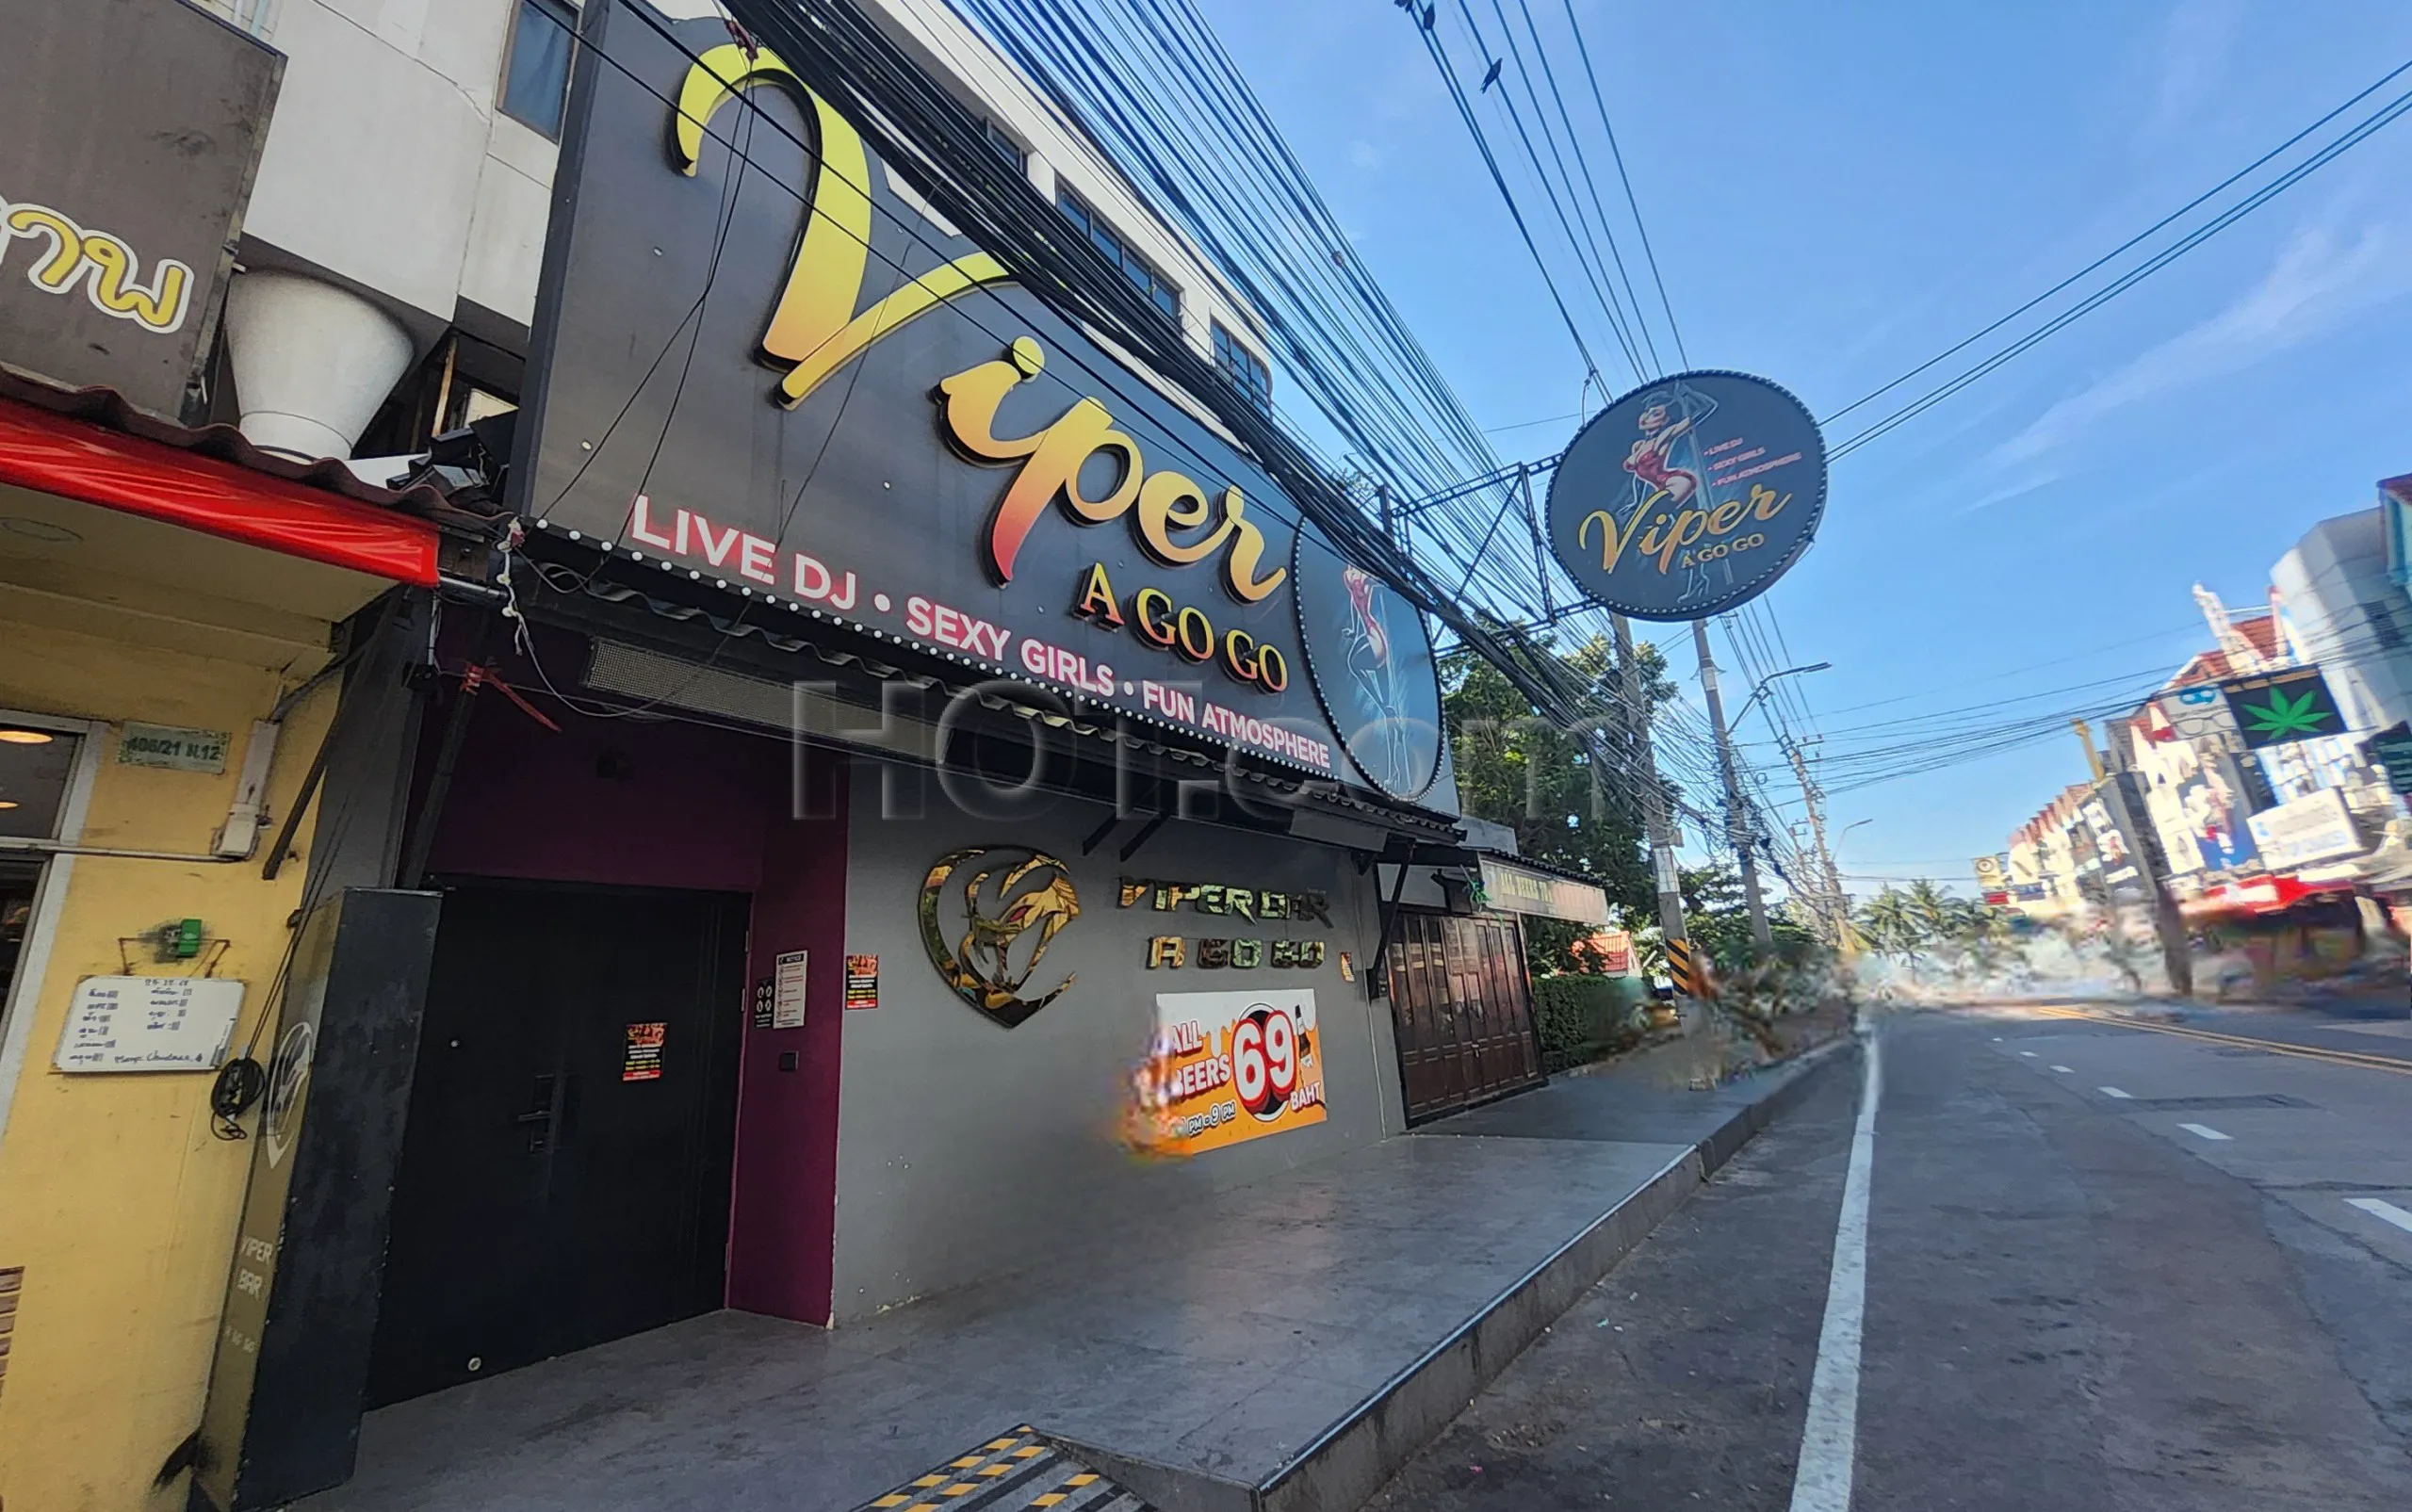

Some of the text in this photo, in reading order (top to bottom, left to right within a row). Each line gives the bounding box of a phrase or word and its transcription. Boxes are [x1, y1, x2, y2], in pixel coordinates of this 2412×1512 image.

[671, 43, 1287, 603] Viper
[1578, 482, 1793, 575] Viper
[1681, 533, 1765, 569] A GO GO
[632, 494, 1331, 769] LIVE DJ SEXY GIRLS FUN ATMOSPHERE
[1076, 561, 1289, 693] A GO GO
[1118, 875, 1257, 925] VIPER
[1147, 935, 1186, 969] A
[1232, 1011, 1296, 1110] 69
[1188, 1114, 1203, 1136] PM
[1211, 1103, 1221, 1127] 9
[1221, 1099, 1236, 1122] PM
[1290, 1081, 1321, 1112] BAHT
